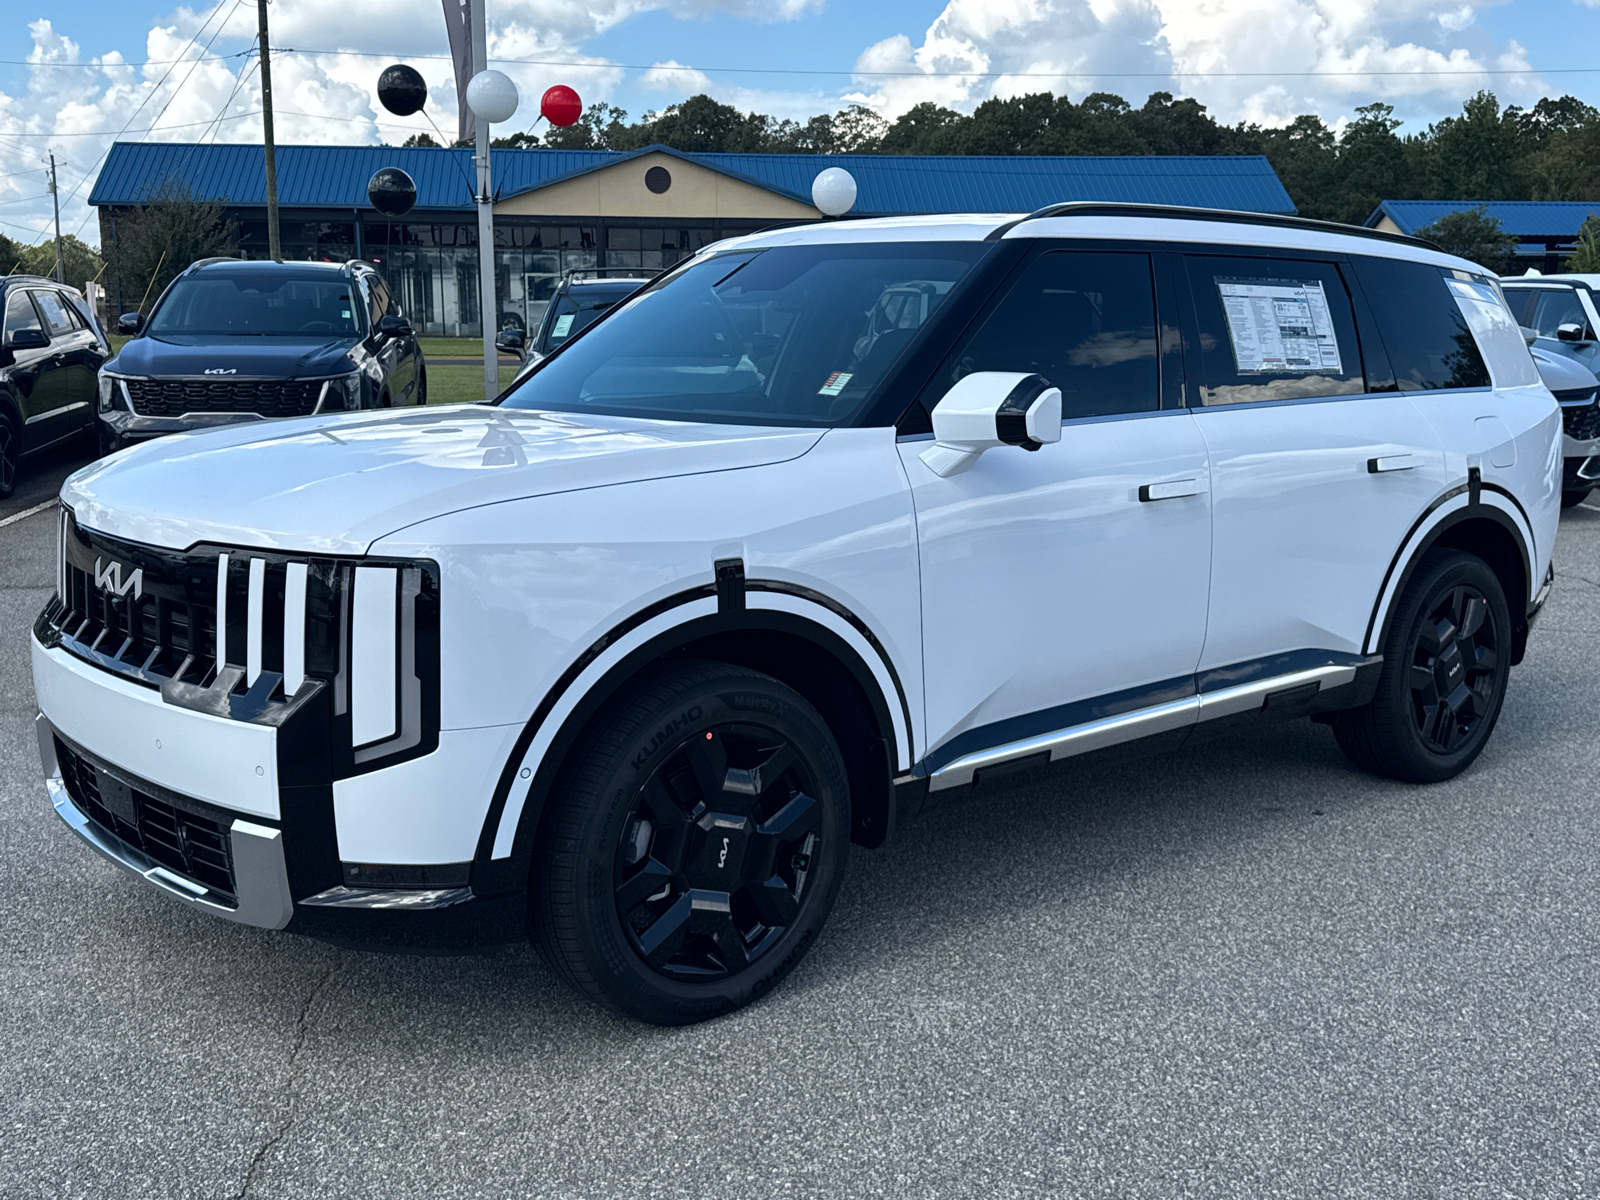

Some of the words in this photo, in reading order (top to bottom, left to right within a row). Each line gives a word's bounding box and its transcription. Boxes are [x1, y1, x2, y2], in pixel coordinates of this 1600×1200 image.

[94, 556, 143, 601] KIA
[630, 705, 704, 771] KUMHO
[611, 788, 624, 810] R20
[752, 928, 814, 994] KUMHO
